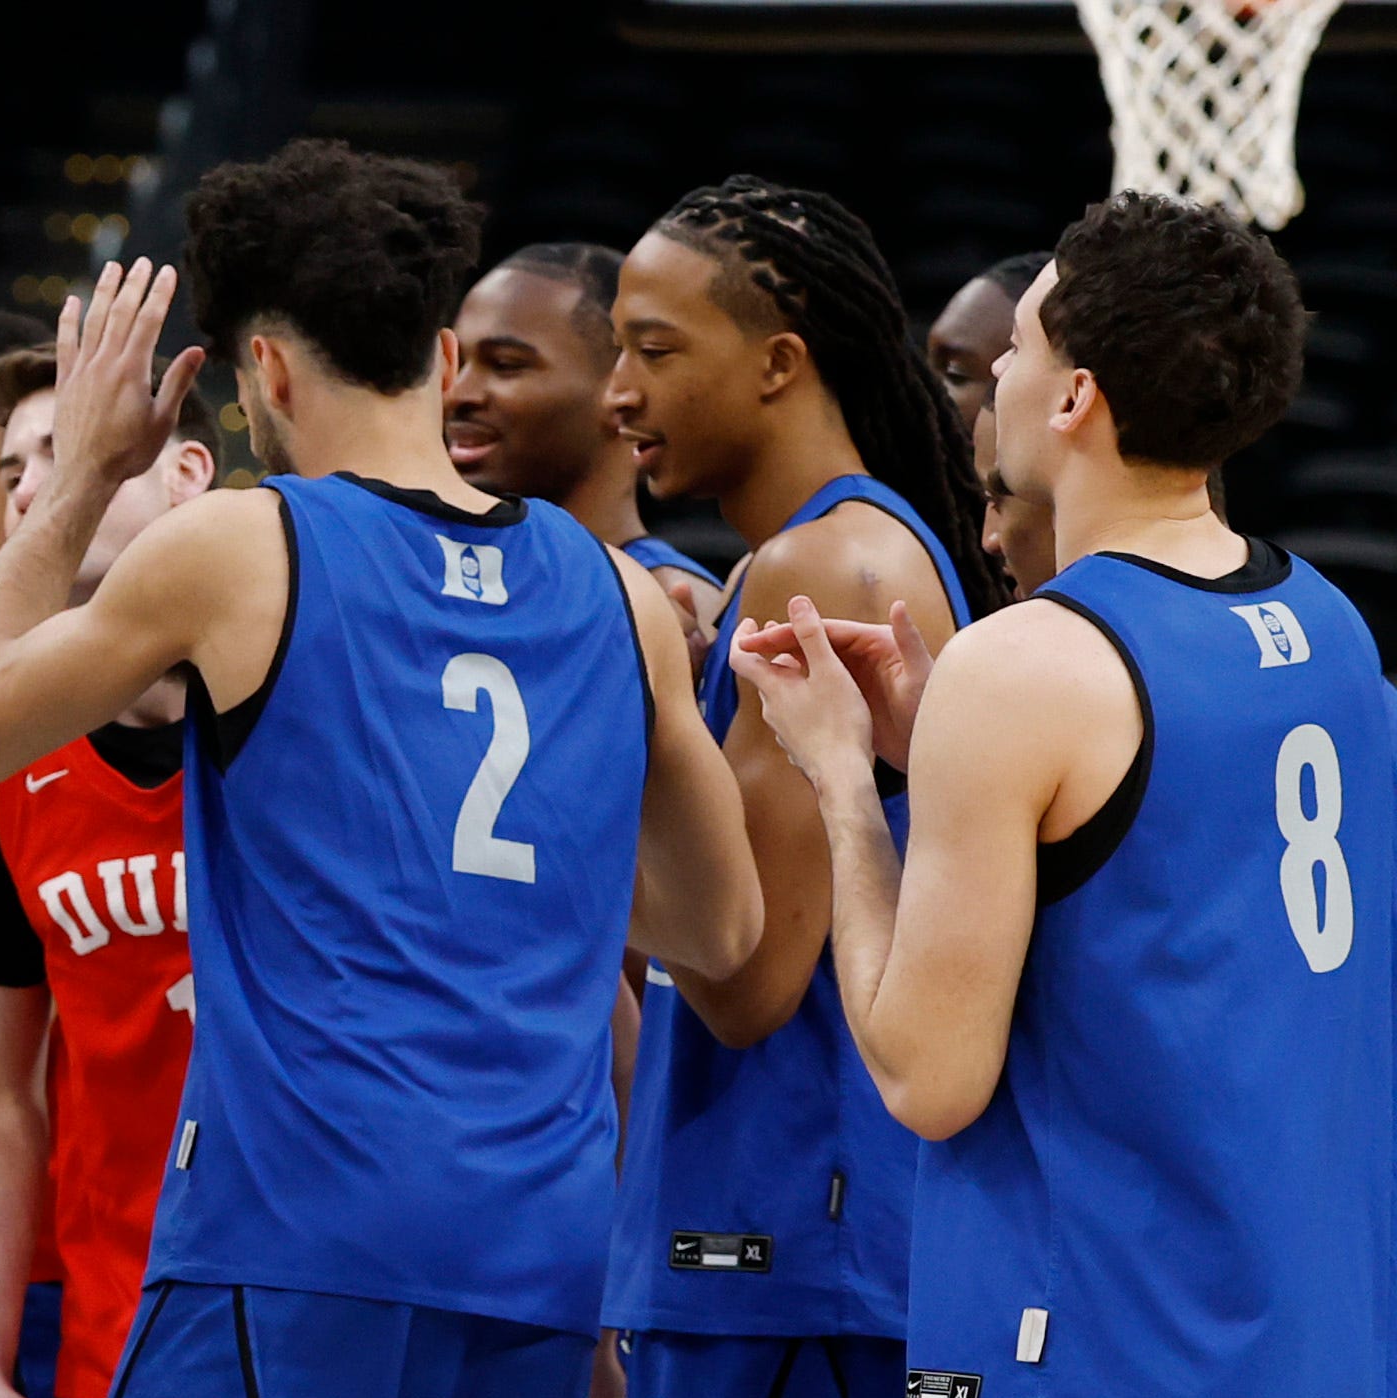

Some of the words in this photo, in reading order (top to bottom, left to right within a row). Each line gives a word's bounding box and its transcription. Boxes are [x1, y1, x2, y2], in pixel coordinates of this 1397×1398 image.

[441, 652, 536, 884] 2
[1275, 723, 1354, 974] 8
[745, 1244, 763, 1261] XL
